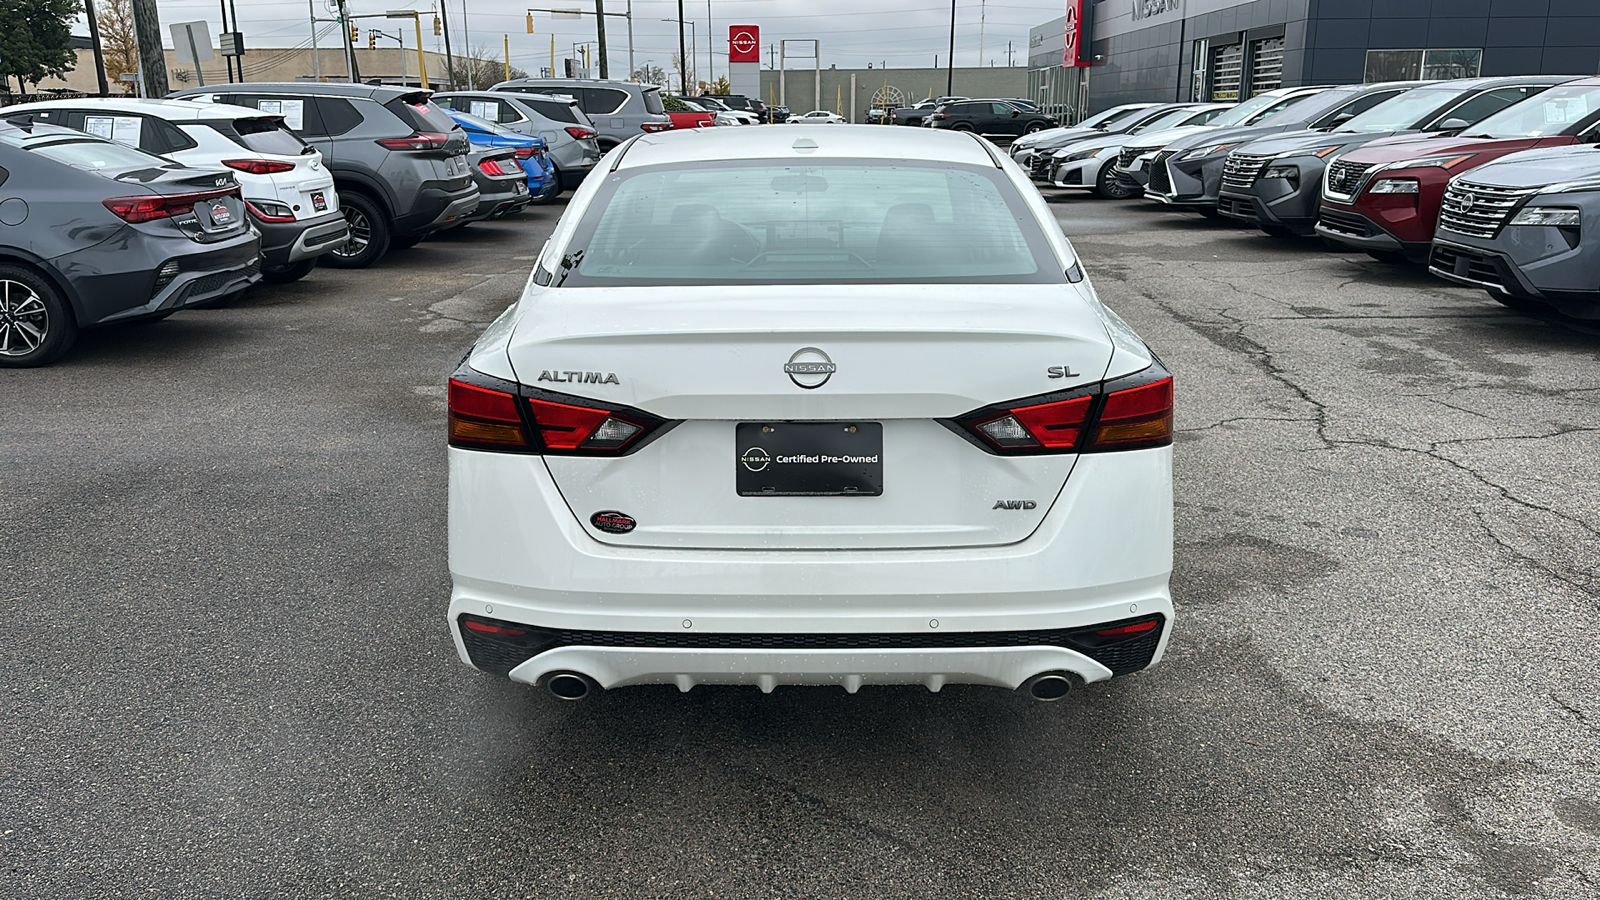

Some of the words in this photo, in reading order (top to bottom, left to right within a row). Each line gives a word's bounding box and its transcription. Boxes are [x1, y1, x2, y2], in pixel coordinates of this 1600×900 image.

[785, 364, 835, 372] NISSAN
[1047, 365, 1081, 379] SL
[537, 370, 620, 385] ALTIMA
[776, 454, 819, 464] Certified
[821, 454, 879, 464] Pre-Owned
[992, 499, 1037, 510] AWD
[596, 516, 631, 525] HALLMARK
[611, 522, 633, 530] GROUP
